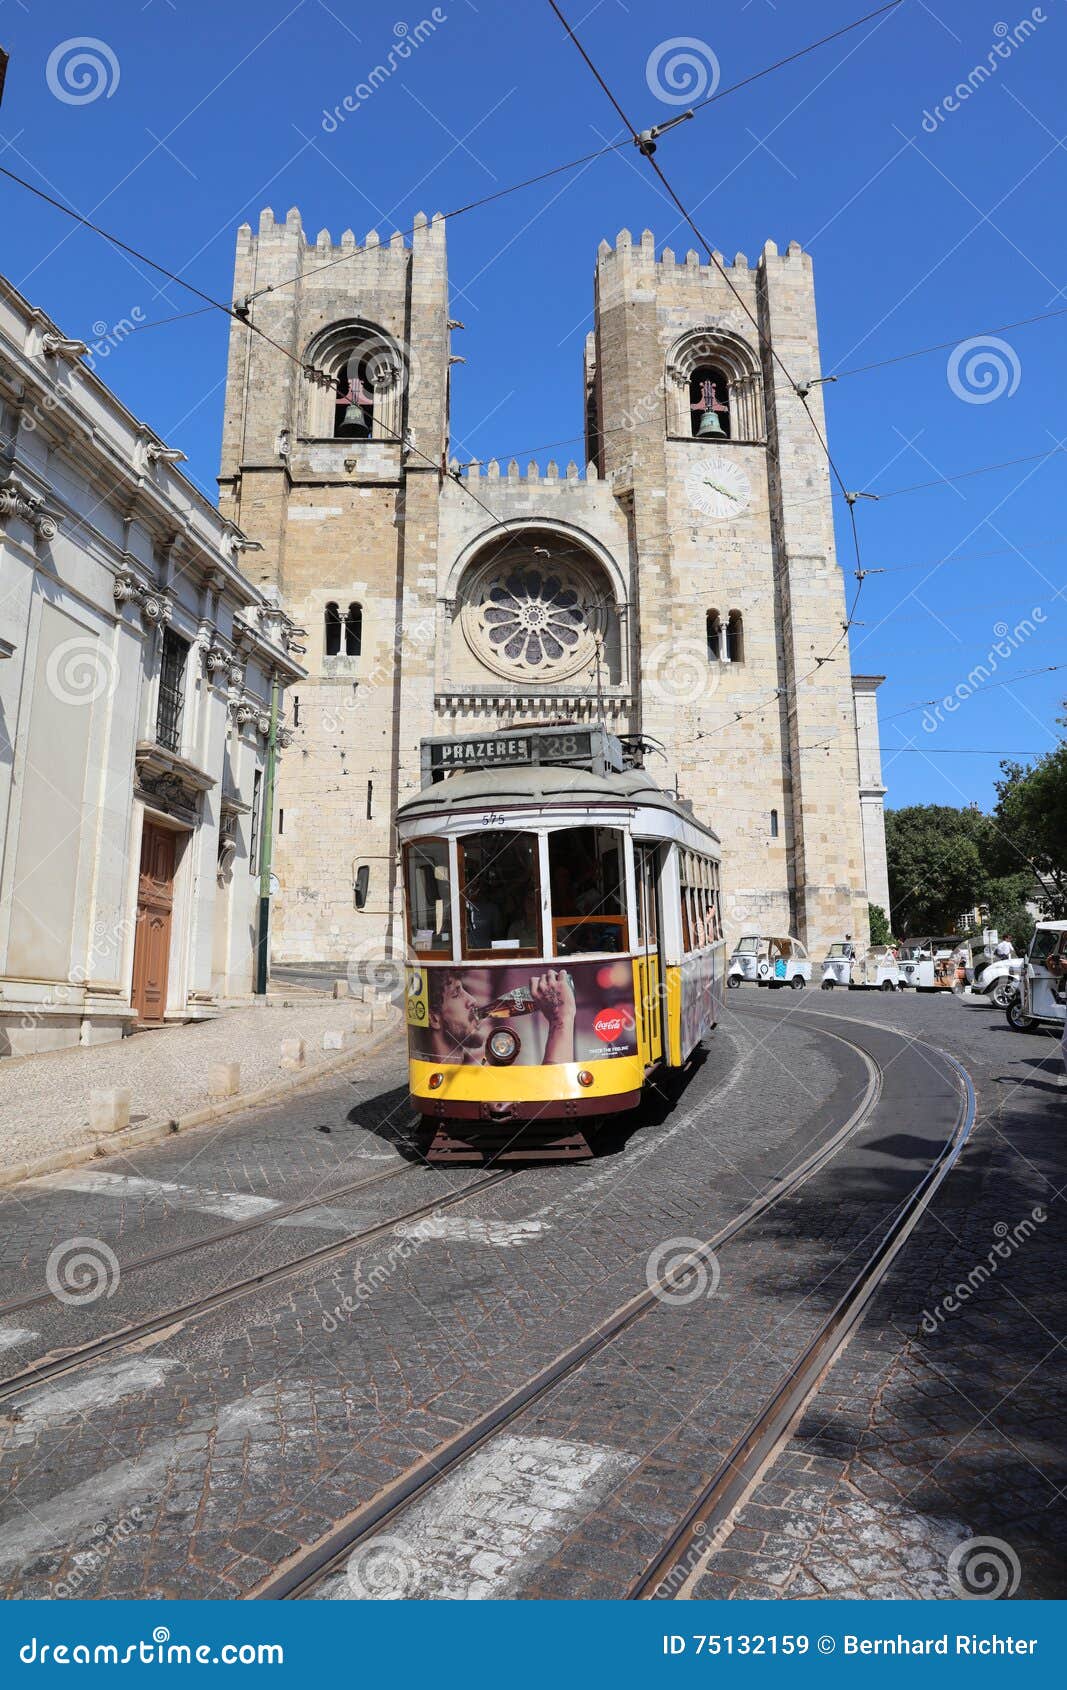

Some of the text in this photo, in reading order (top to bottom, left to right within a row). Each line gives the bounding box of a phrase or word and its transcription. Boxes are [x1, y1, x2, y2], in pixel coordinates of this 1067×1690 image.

[442, 735, 578, 759] PRAZERES 28
[482, 814, 505, 826] 575
